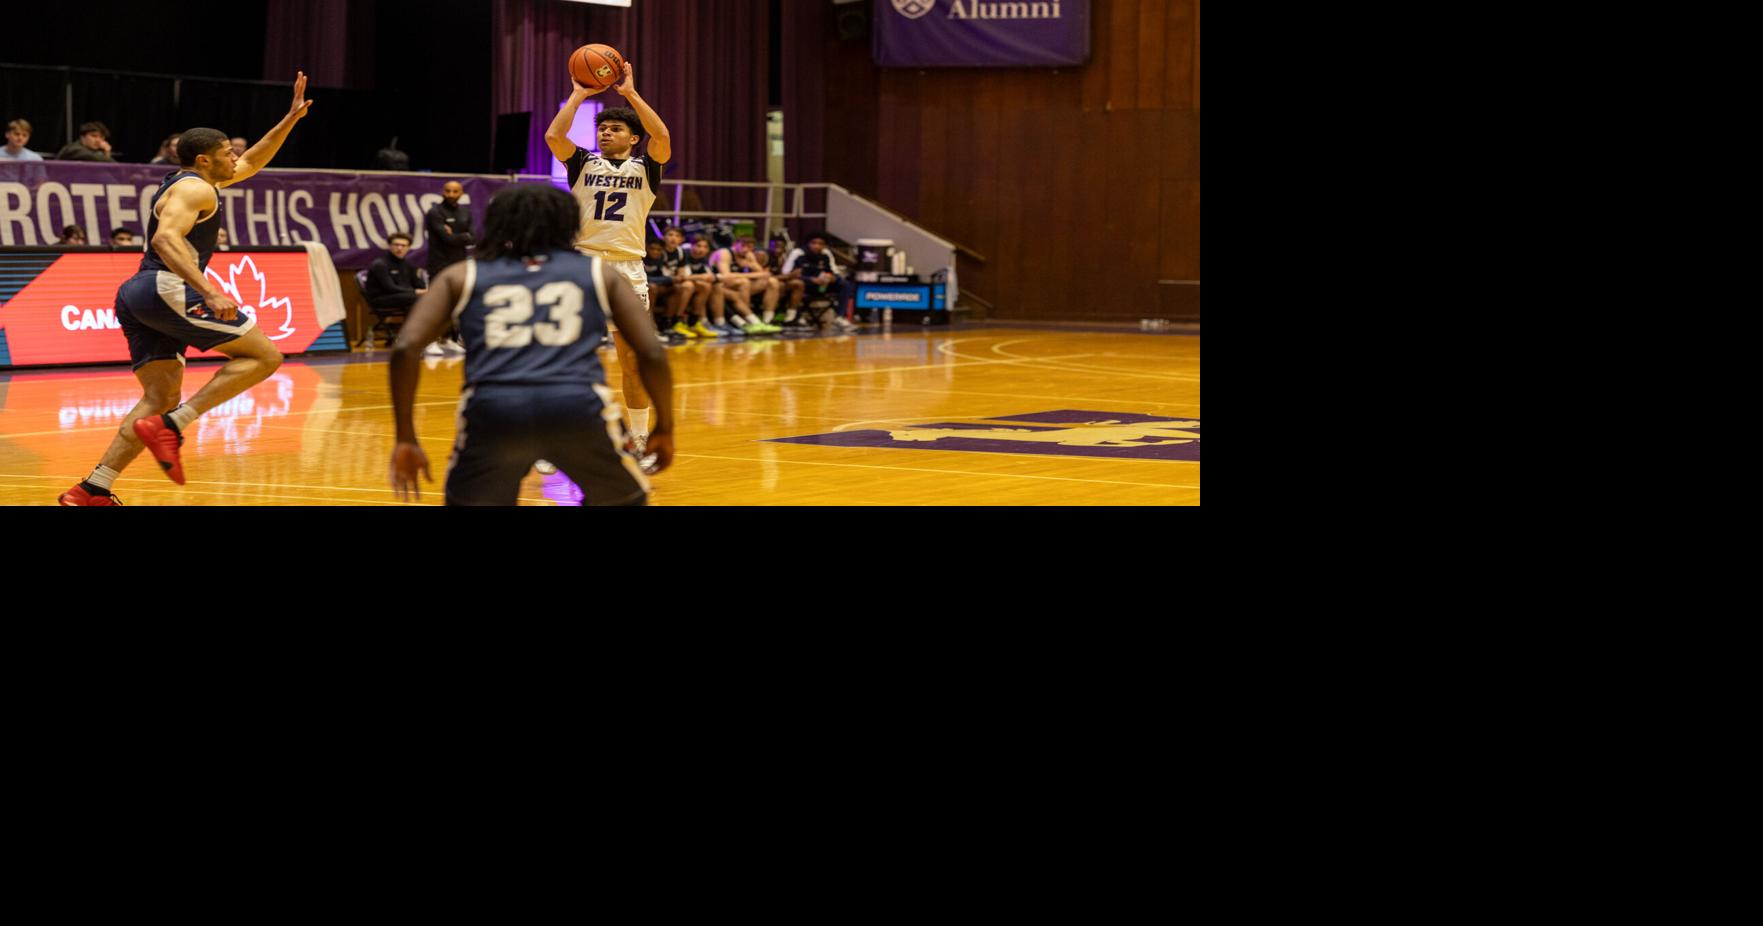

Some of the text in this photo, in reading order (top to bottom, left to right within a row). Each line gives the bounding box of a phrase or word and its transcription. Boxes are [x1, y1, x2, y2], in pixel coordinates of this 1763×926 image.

[947, 0, 1060, 19] Alumni
[584, 173, 643, 190] WESTERN
[218, 187, 322, 246] THIS
[328, 191, 471, 250] HOU
[593, 190, 628, 221] 12
[483, 281, 584, 350] 23
